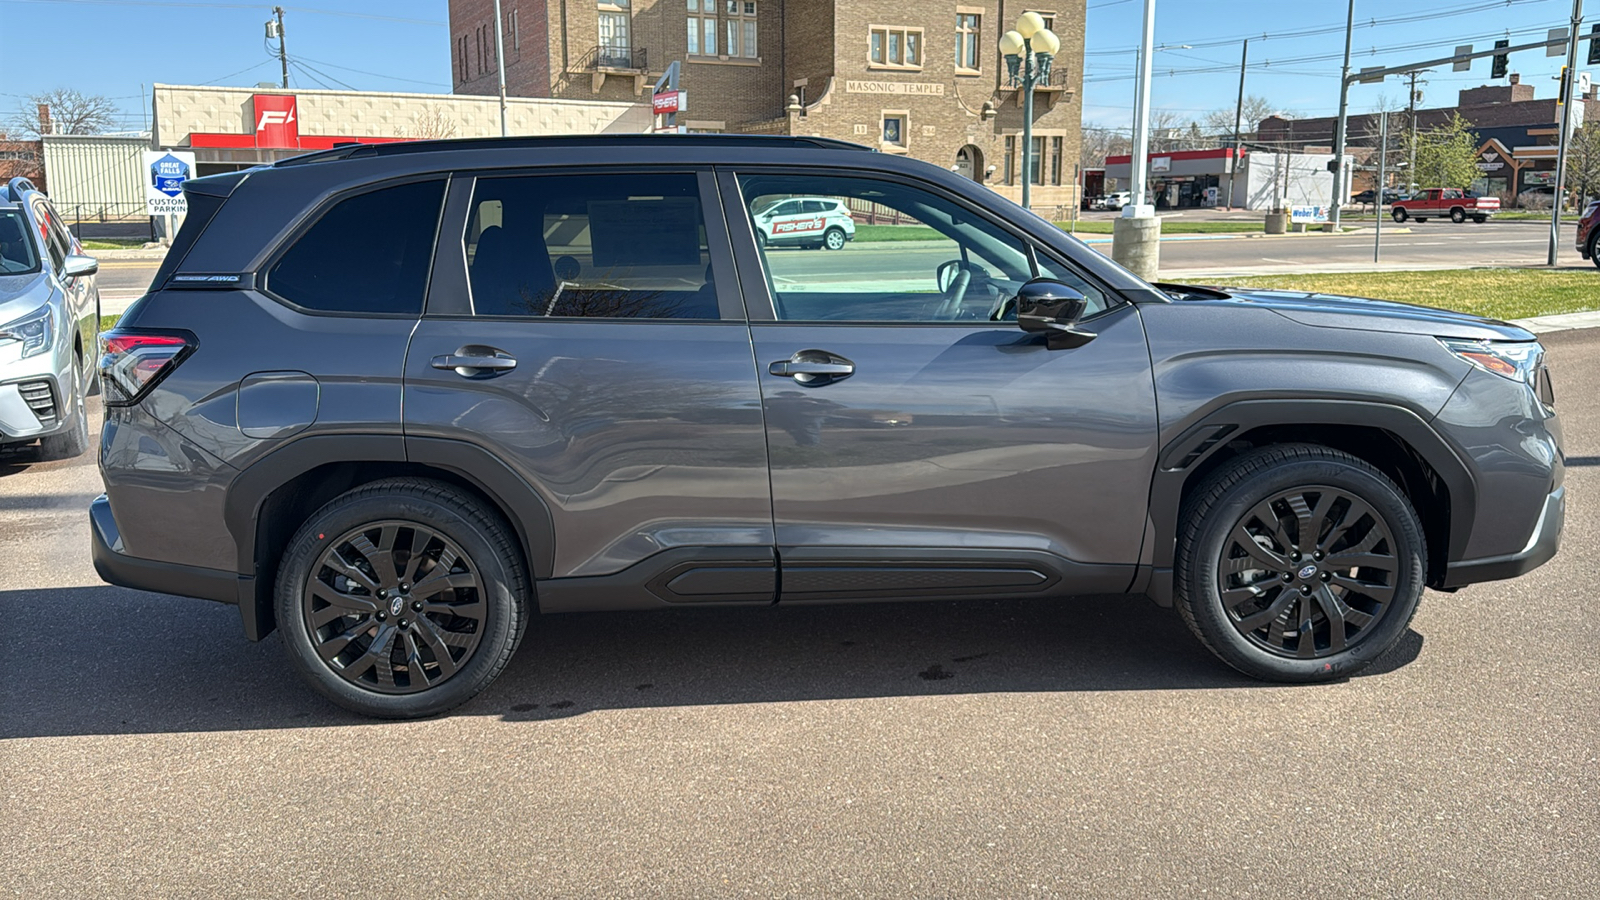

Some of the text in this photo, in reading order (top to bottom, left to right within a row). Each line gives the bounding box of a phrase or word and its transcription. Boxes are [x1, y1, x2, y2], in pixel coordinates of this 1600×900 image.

[848, 82, 943, 94] MASONIC TEMPLE
[148, 198, 186, 206] CUSTOM
[154, 205, 186, 213] PARKIN
[1292, 207, 1312, 217] Weber
[775, 219, 823, 233] FISHER'S
